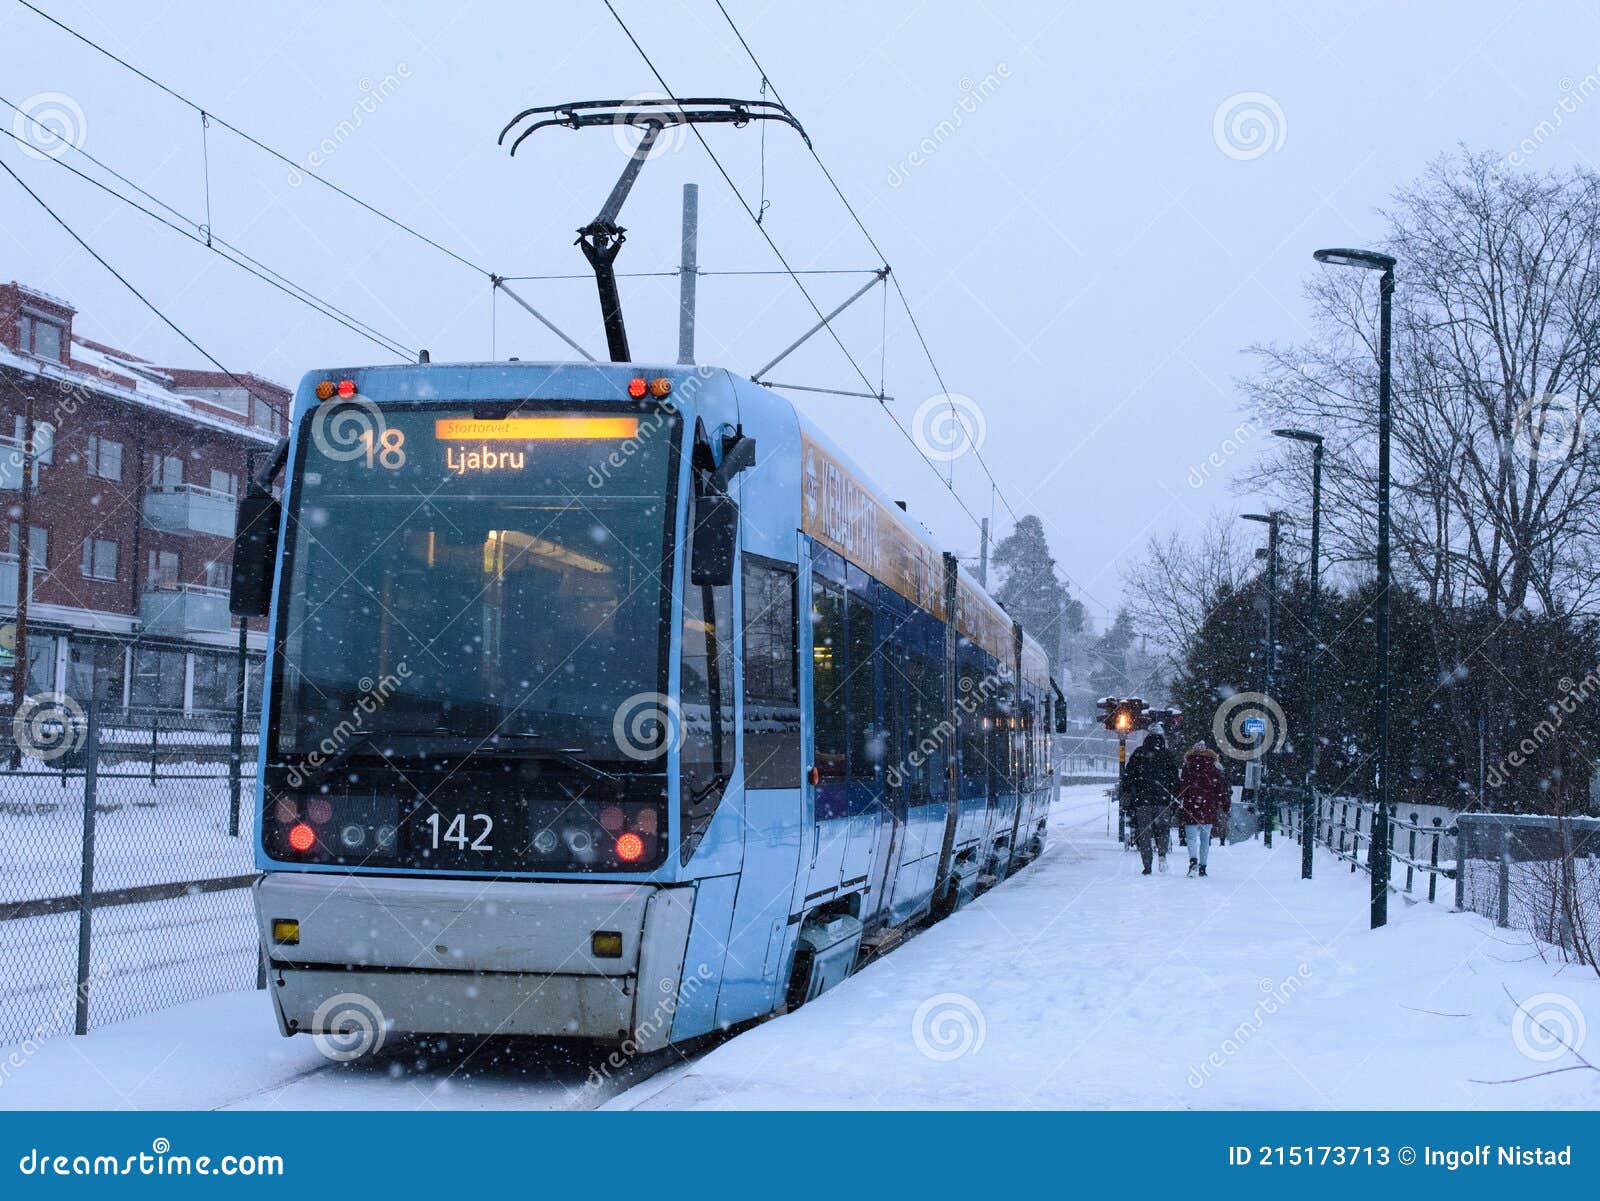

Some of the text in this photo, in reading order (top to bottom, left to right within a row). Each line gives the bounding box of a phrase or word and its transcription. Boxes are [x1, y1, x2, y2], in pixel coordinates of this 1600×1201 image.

[448, 422, 510, 434] Stortorvet
[359, 428, 406, 469] 18
[447, 445, 524, 475] Ljabru
[426, 813, 493, 851] 142
